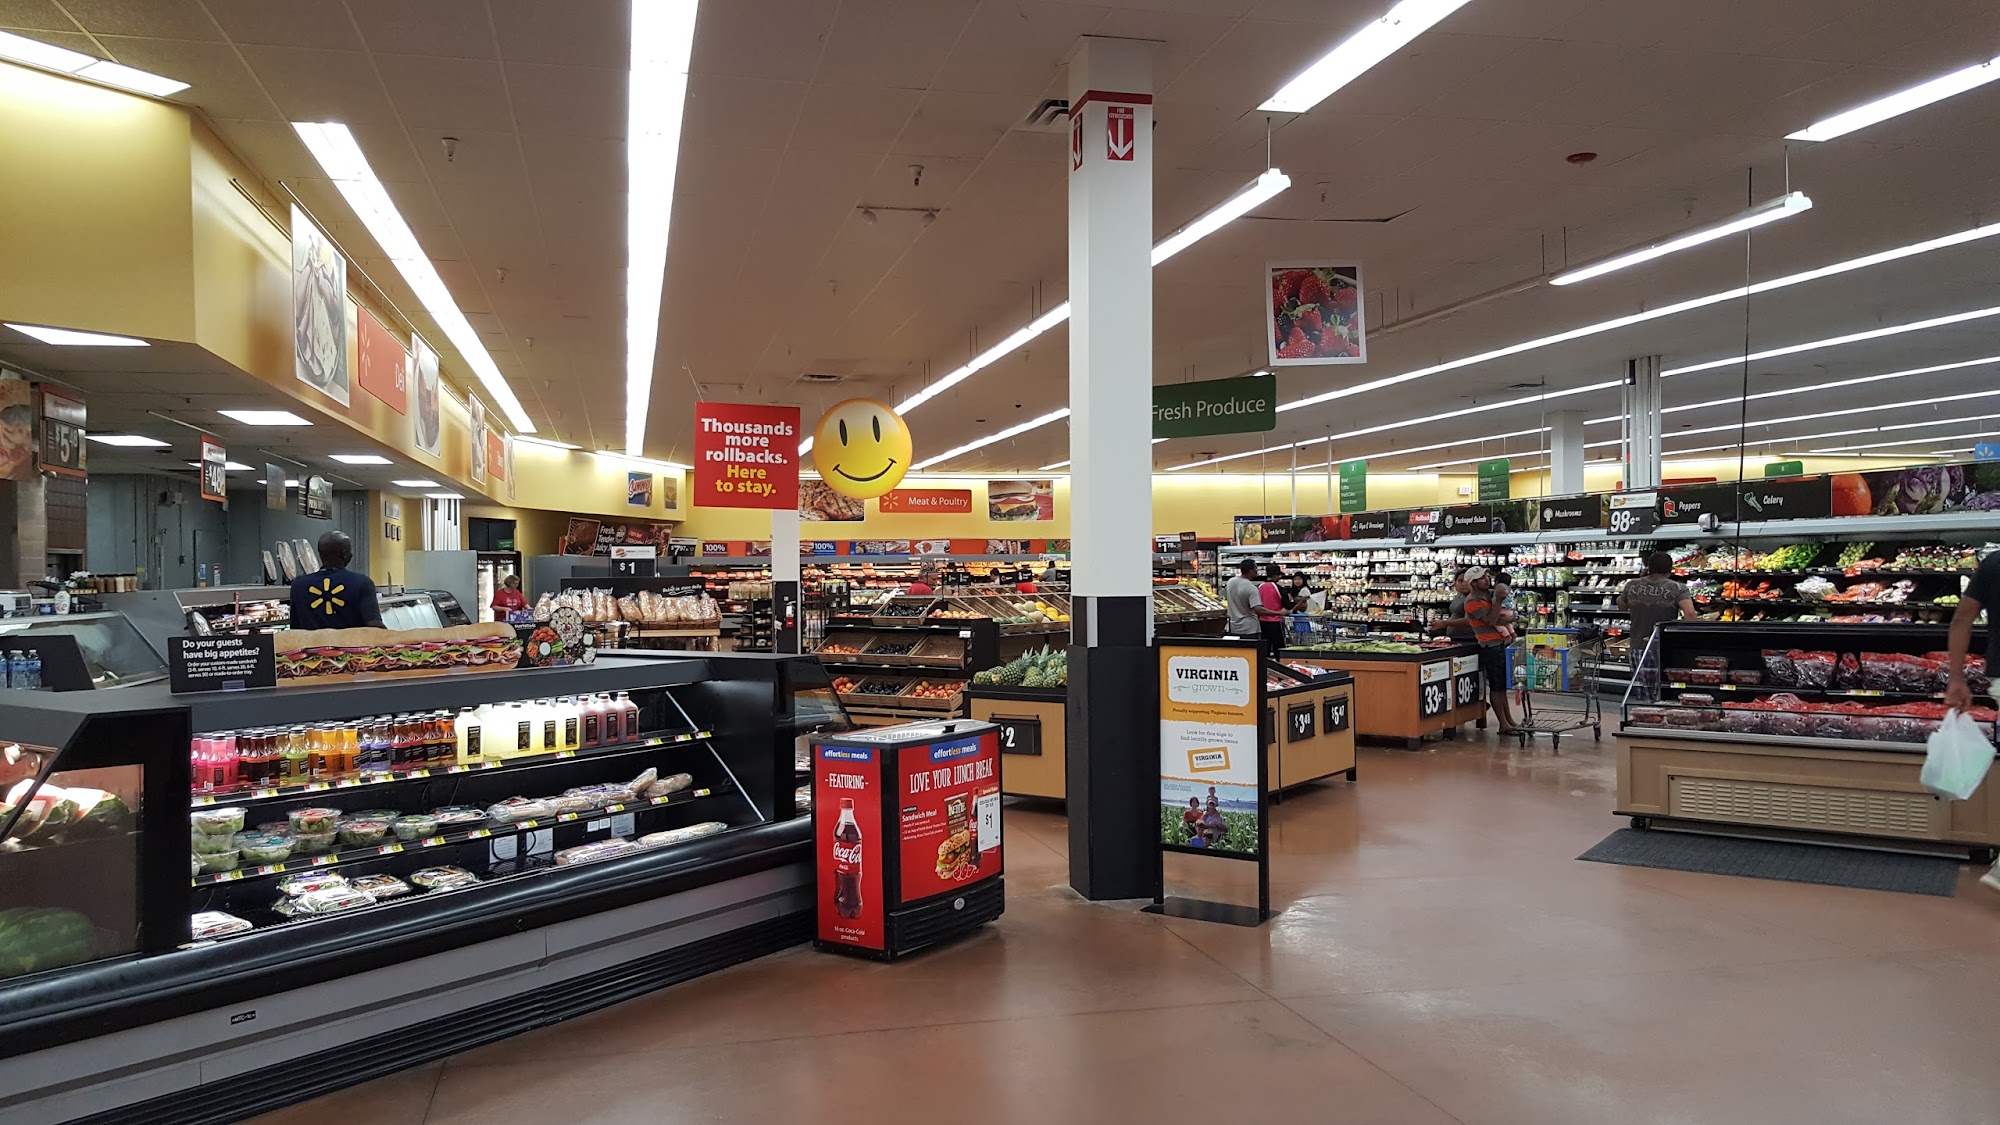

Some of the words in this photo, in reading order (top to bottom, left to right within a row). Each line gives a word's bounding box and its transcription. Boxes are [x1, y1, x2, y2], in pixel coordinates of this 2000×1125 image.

[1197, 397, 1266, 417] Produce
[701, 418, 793, 436] Thousands
[726, 435, 769, 447] more
[706, 448, 788, 464] rollbacks.
[727, 464, 766, 479] Here
[716, 479, 734, 492] to
[738, 480, 776, 497] stay.
[908, 497, 929, 506] Meat
[931, 497, 937, 505] &
[939, 497, 968, 507] Poultry
[1679, 501, 1701, 512] Peppers
[1763, 495, 1783, 506] Celery
[1455, 516, 1473, 525] Packaged
[182, 640, 195, 648] Do
[196, 640, 215, 649] your
[216, 639, 243, 648] guests
[183, 650, 203, 659] have
[204, 650, 218, 659] big
[219, 647, 260, 658] appetites?
[1176, 669, 1239, 681] VIRGINIA
[1192, 684, 1224, 693] grown
[825, 750, 850, 758] effortless
[934, 747, 961, 758] effortless
[962, 743, 976, 754] meals
[910, 772, 930, 793] LOVE
[932, 768, 951, 789] YOUR
[954, 763, 974, 785] LUNCH
[976, 758, 993, 780] BREAK
[902, 812, 925, 822] Sandwich
[926, 809, 937, 817] Meal
